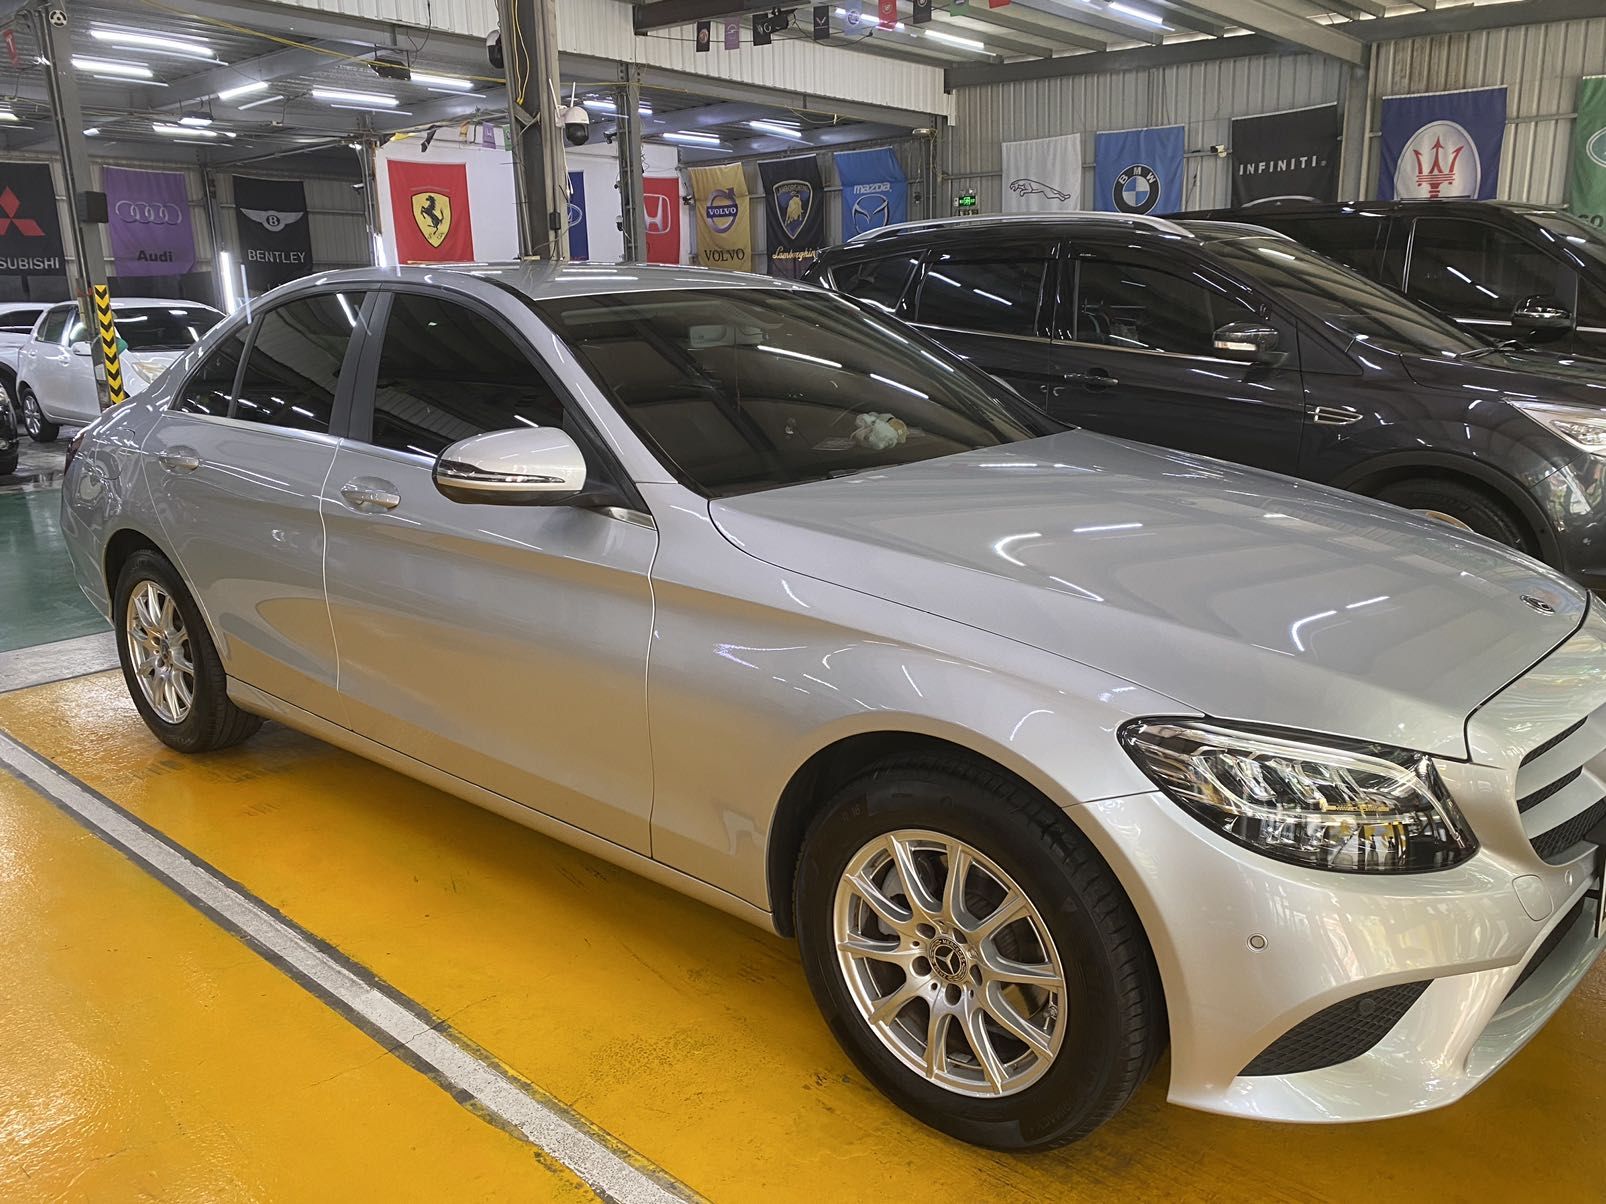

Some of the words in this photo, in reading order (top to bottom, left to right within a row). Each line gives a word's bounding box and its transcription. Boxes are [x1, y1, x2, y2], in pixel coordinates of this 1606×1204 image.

[1118, 166, 1156, 185] BMW
[708, 206, 737, 216] VOLVO
[268, 215, 279, 226] B
[137, 250, 173, 262] Audi
[248, 249, 305, 263] BENTLEY
[704, 248, 745, 261] VOLVO
[0, 257, 59, 269] SUBISHI
